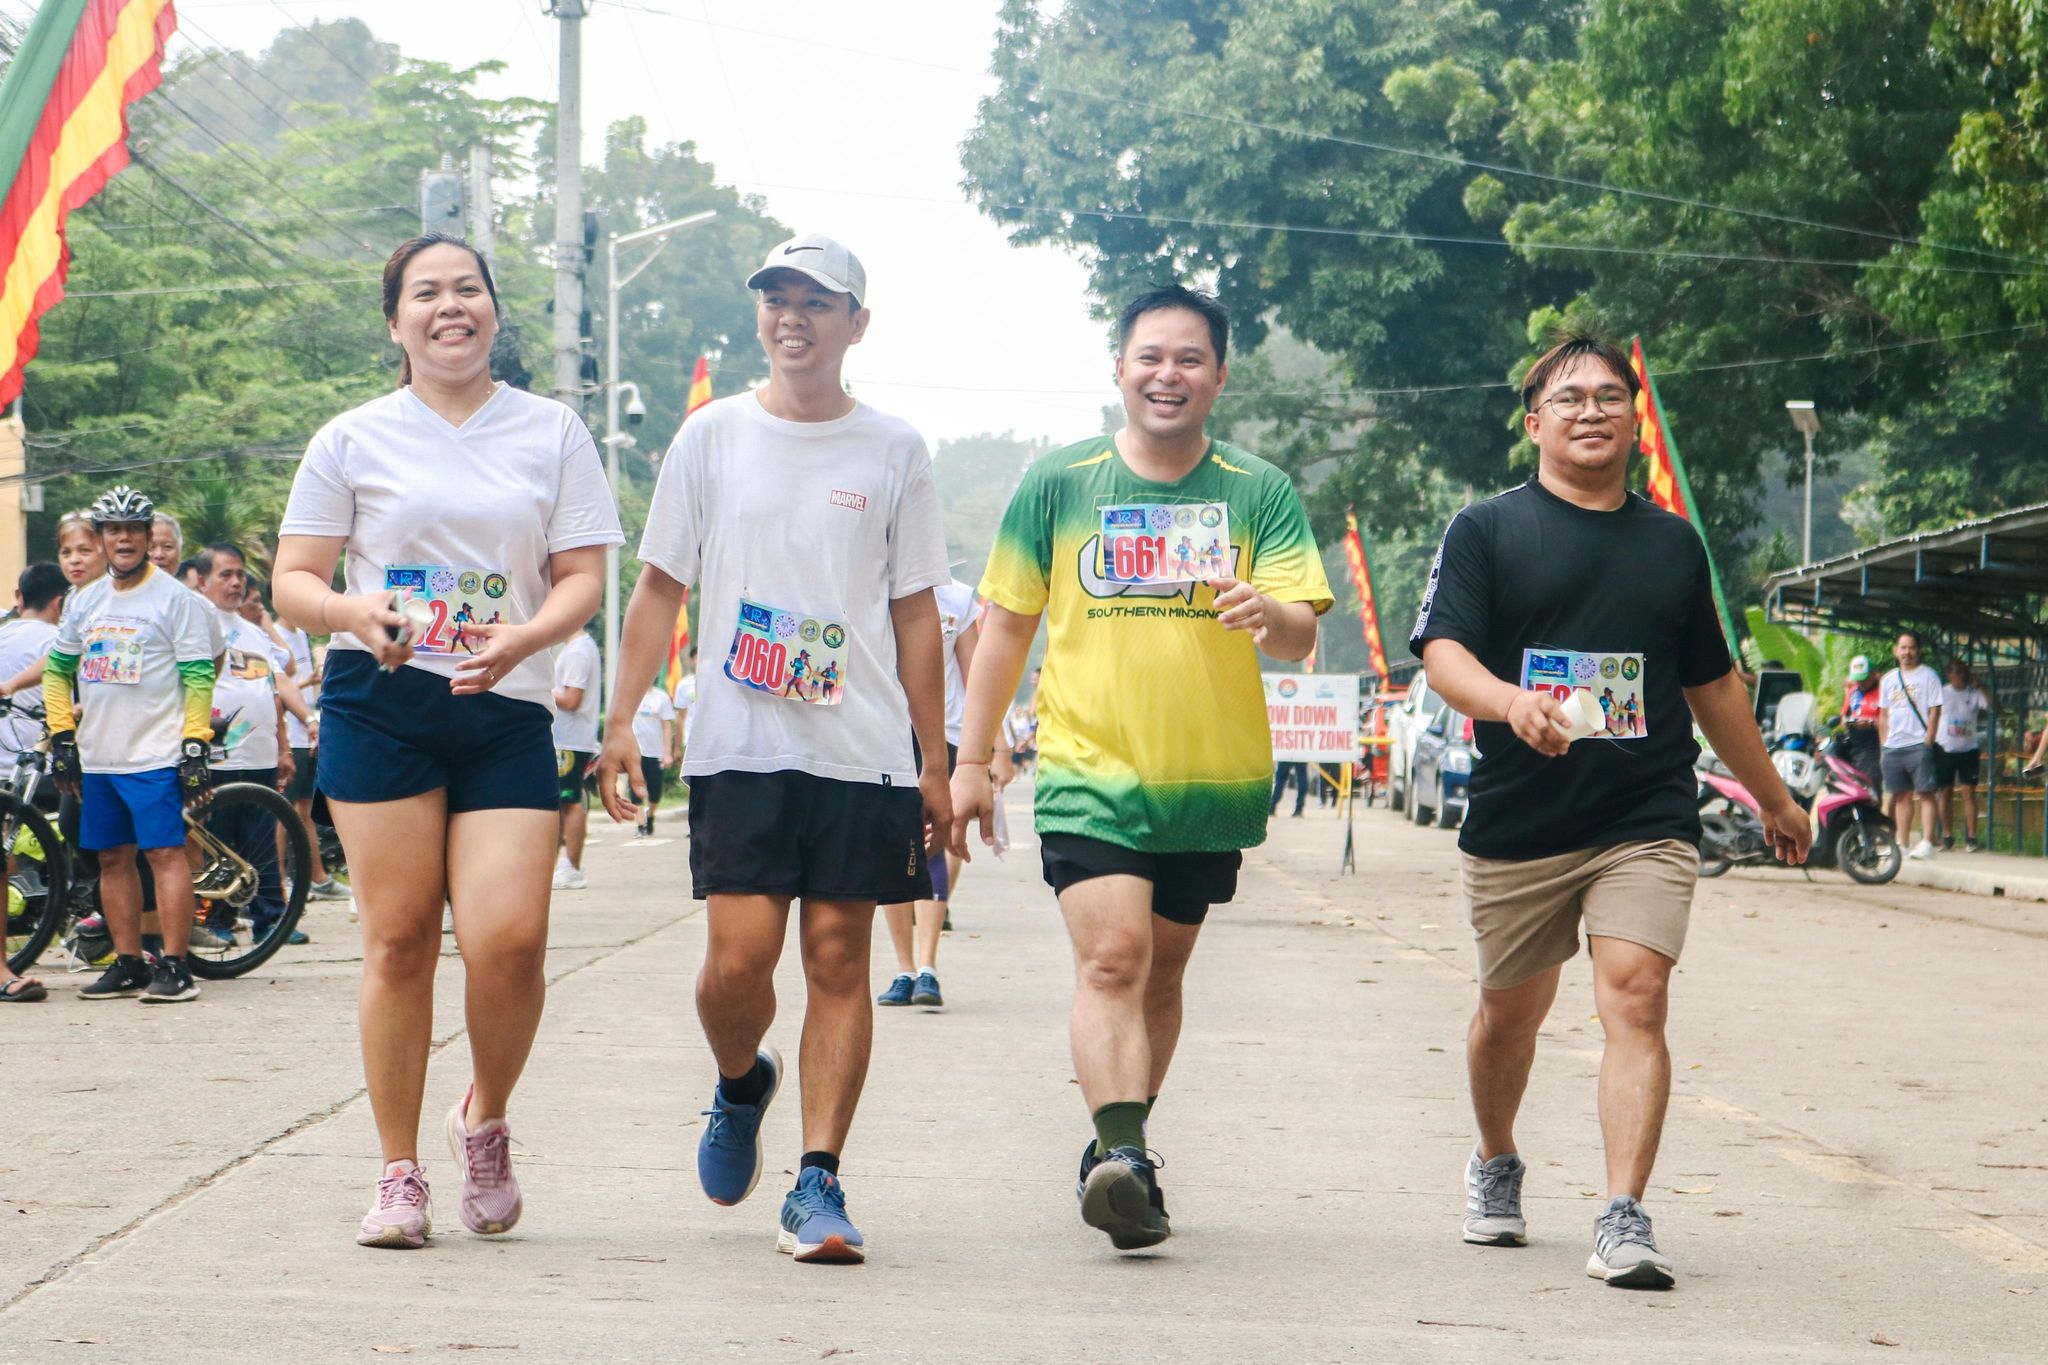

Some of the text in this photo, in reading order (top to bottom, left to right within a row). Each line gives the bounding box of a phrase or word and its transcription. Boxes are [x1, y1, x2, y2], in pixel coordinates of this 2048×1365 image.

[831, 490, 866, 511] MARVEL
[1115, 535, 1168, 579] 661
[1087, 606, 1166, 619] SOUTHERN
[732, 634, 787, 688] 060
[1293, 705, 1337, 726] DOWN
[1319, 730, 1353, 751] ZONE
